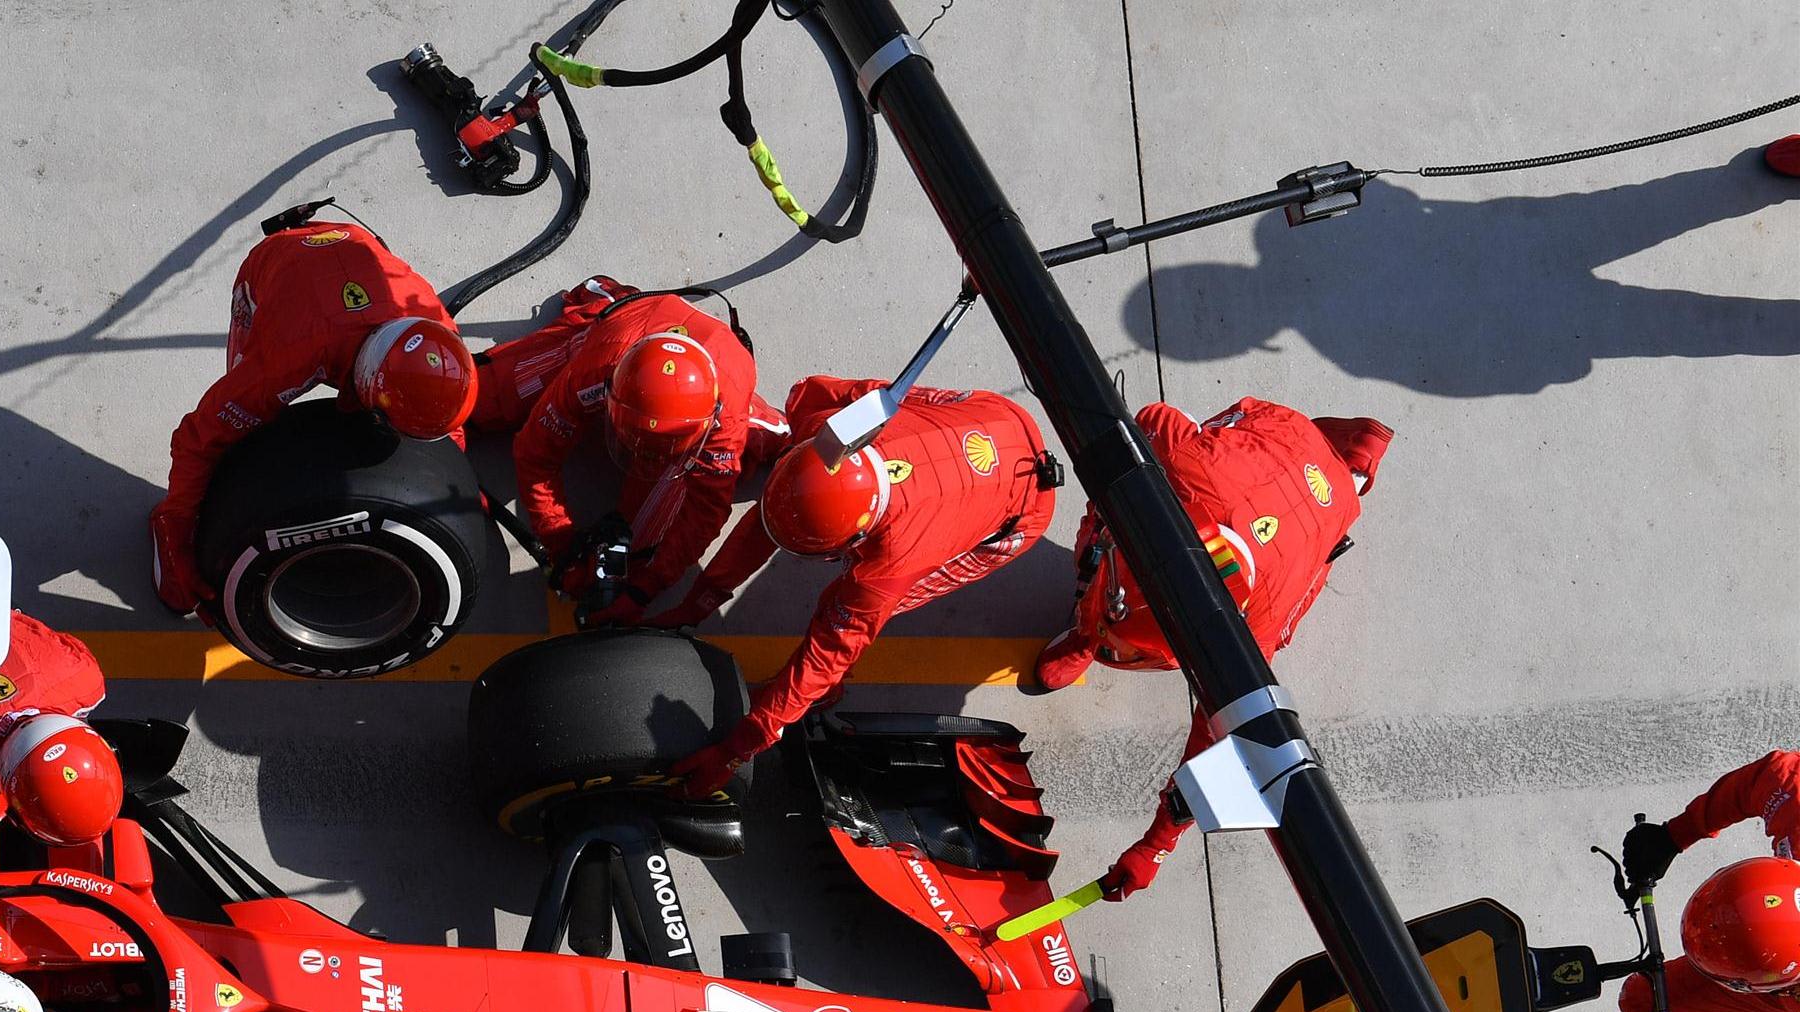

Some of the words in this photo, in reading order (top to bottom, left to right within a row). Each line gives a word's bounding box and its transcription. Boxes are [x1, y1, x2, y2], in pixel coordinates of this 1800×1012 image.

[265, 510, 371, 551] PIRELLI
[426, 626, 444, 648] P
[277, 651, 410, 678] ZERO
[46, 871, 108, 894] KASPERSKY
[647, 854, 693, 957] Lenovo
[89, 942, 144, 958] BLOT
